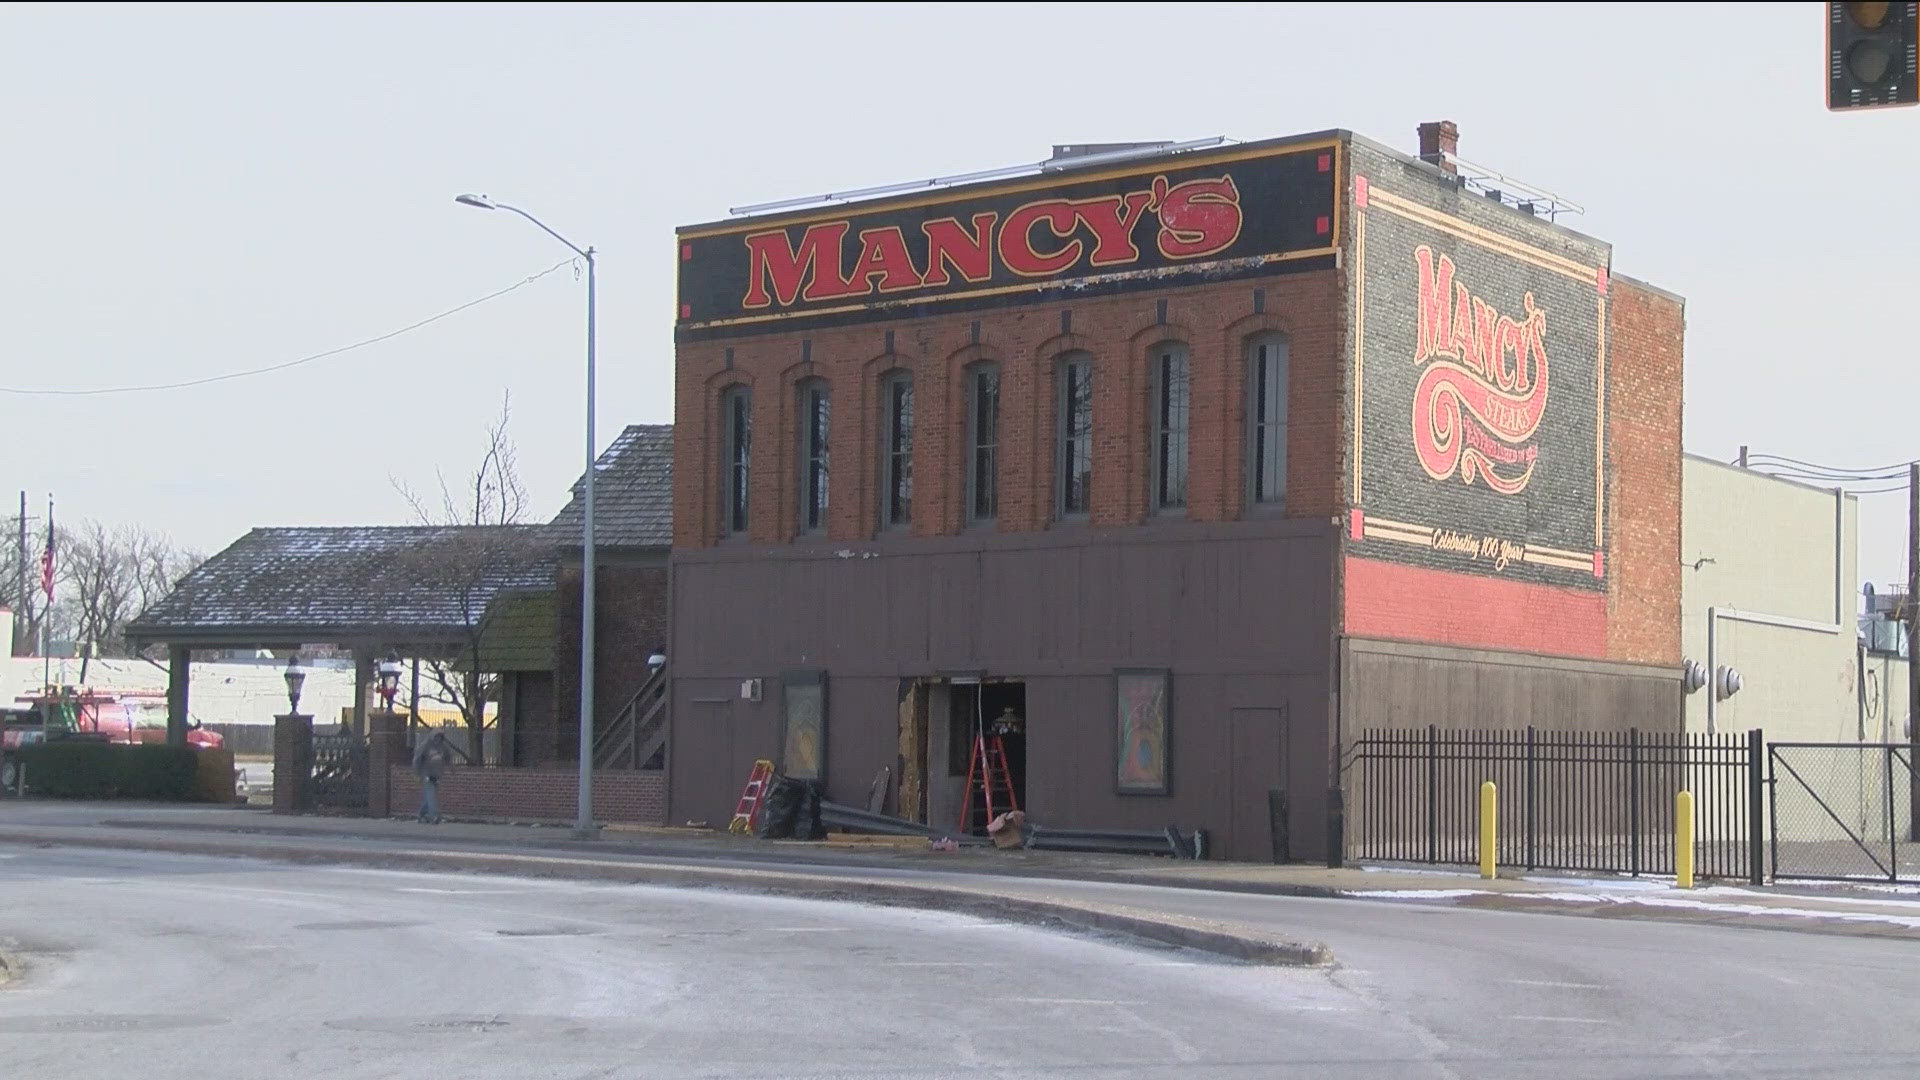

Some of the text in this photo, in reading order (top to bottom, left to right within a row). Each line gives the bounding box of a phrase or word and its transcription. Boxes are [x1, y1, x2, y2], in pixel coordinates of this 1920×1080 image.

[742, 174, 1242, 307] MANCY'S
[1414, 244, 1549, 393] MANCY'S
[1484, 394, 1531, 431] STEAKS
[1432, 528, 1524, 571] Celebrating 100 Years
